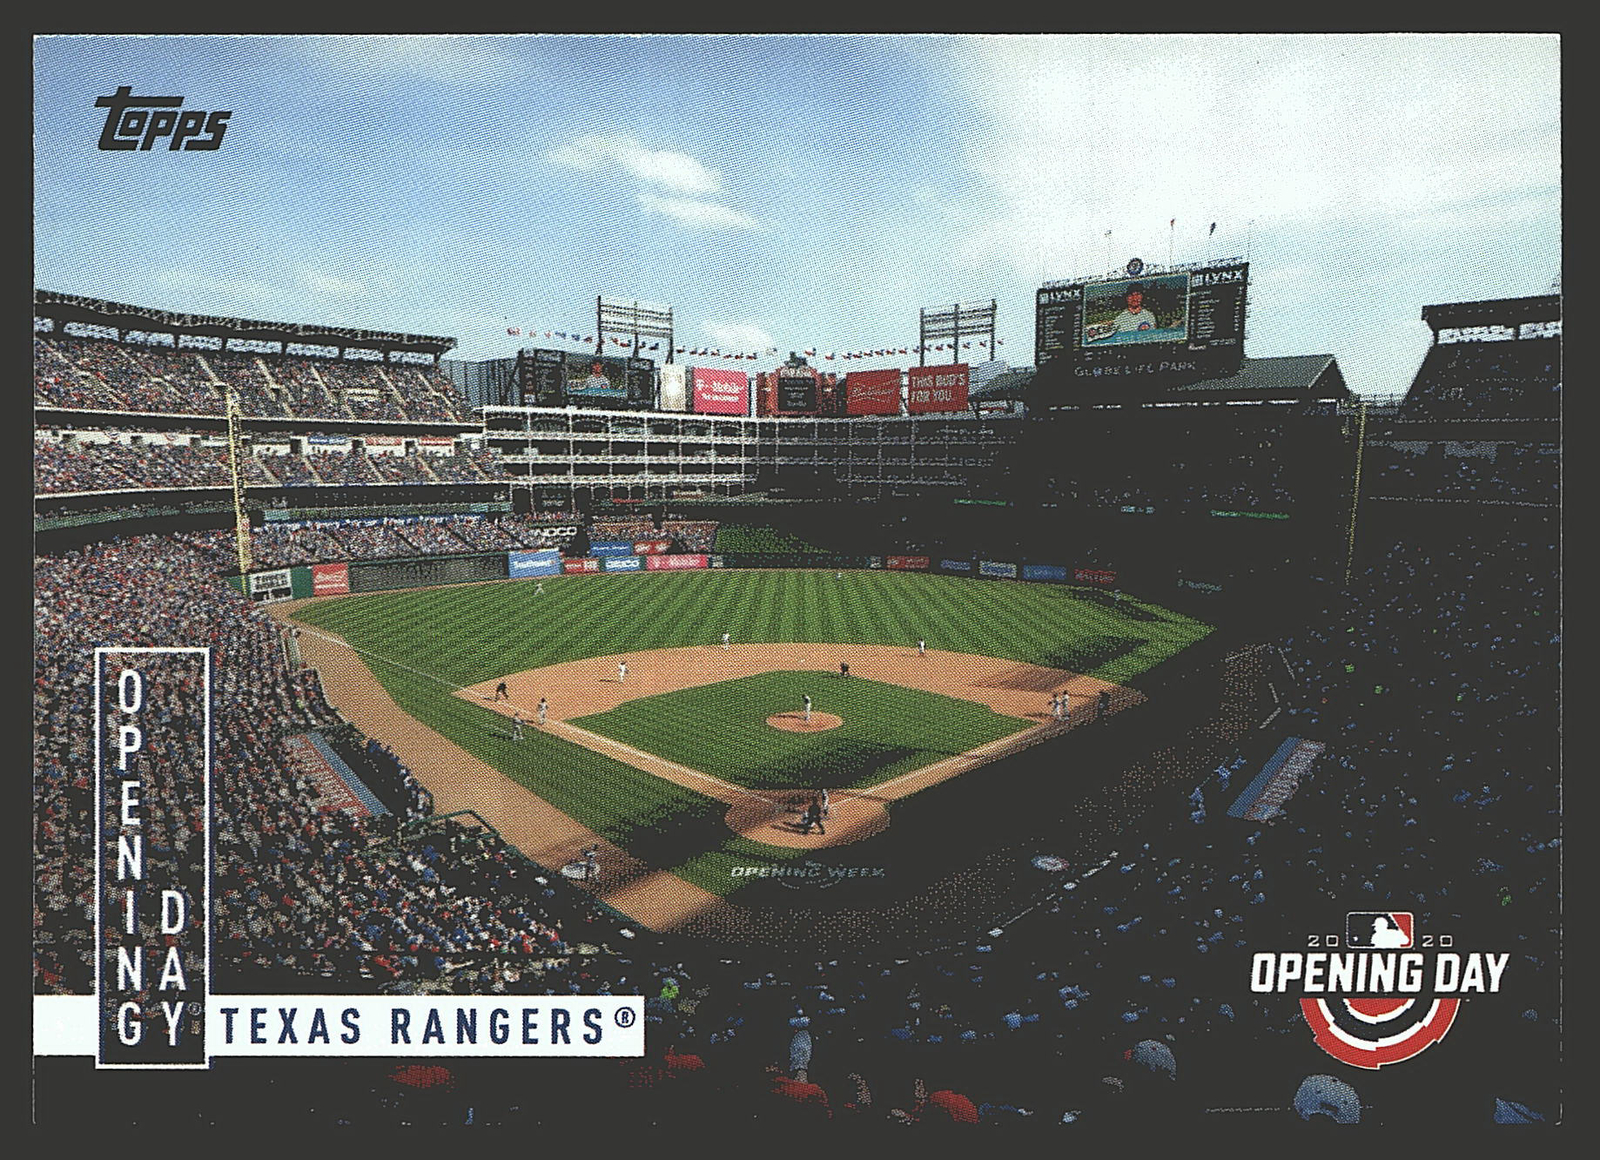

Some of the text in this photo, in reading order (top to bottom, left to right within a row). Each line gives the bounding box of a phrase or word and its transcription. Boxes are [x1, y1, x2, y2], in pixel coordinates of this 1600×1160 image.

[1204, 269, 1244, 285] LYNX
[1050, 288, 1082, 301] LYNX
[118, 668, 142, 1046] OPENING
[731, 865, 821, 878] OPENING
[1250, 952, 1510, 993] OPENING DAY
[219, 1007, 361, 1045] TEXAS
